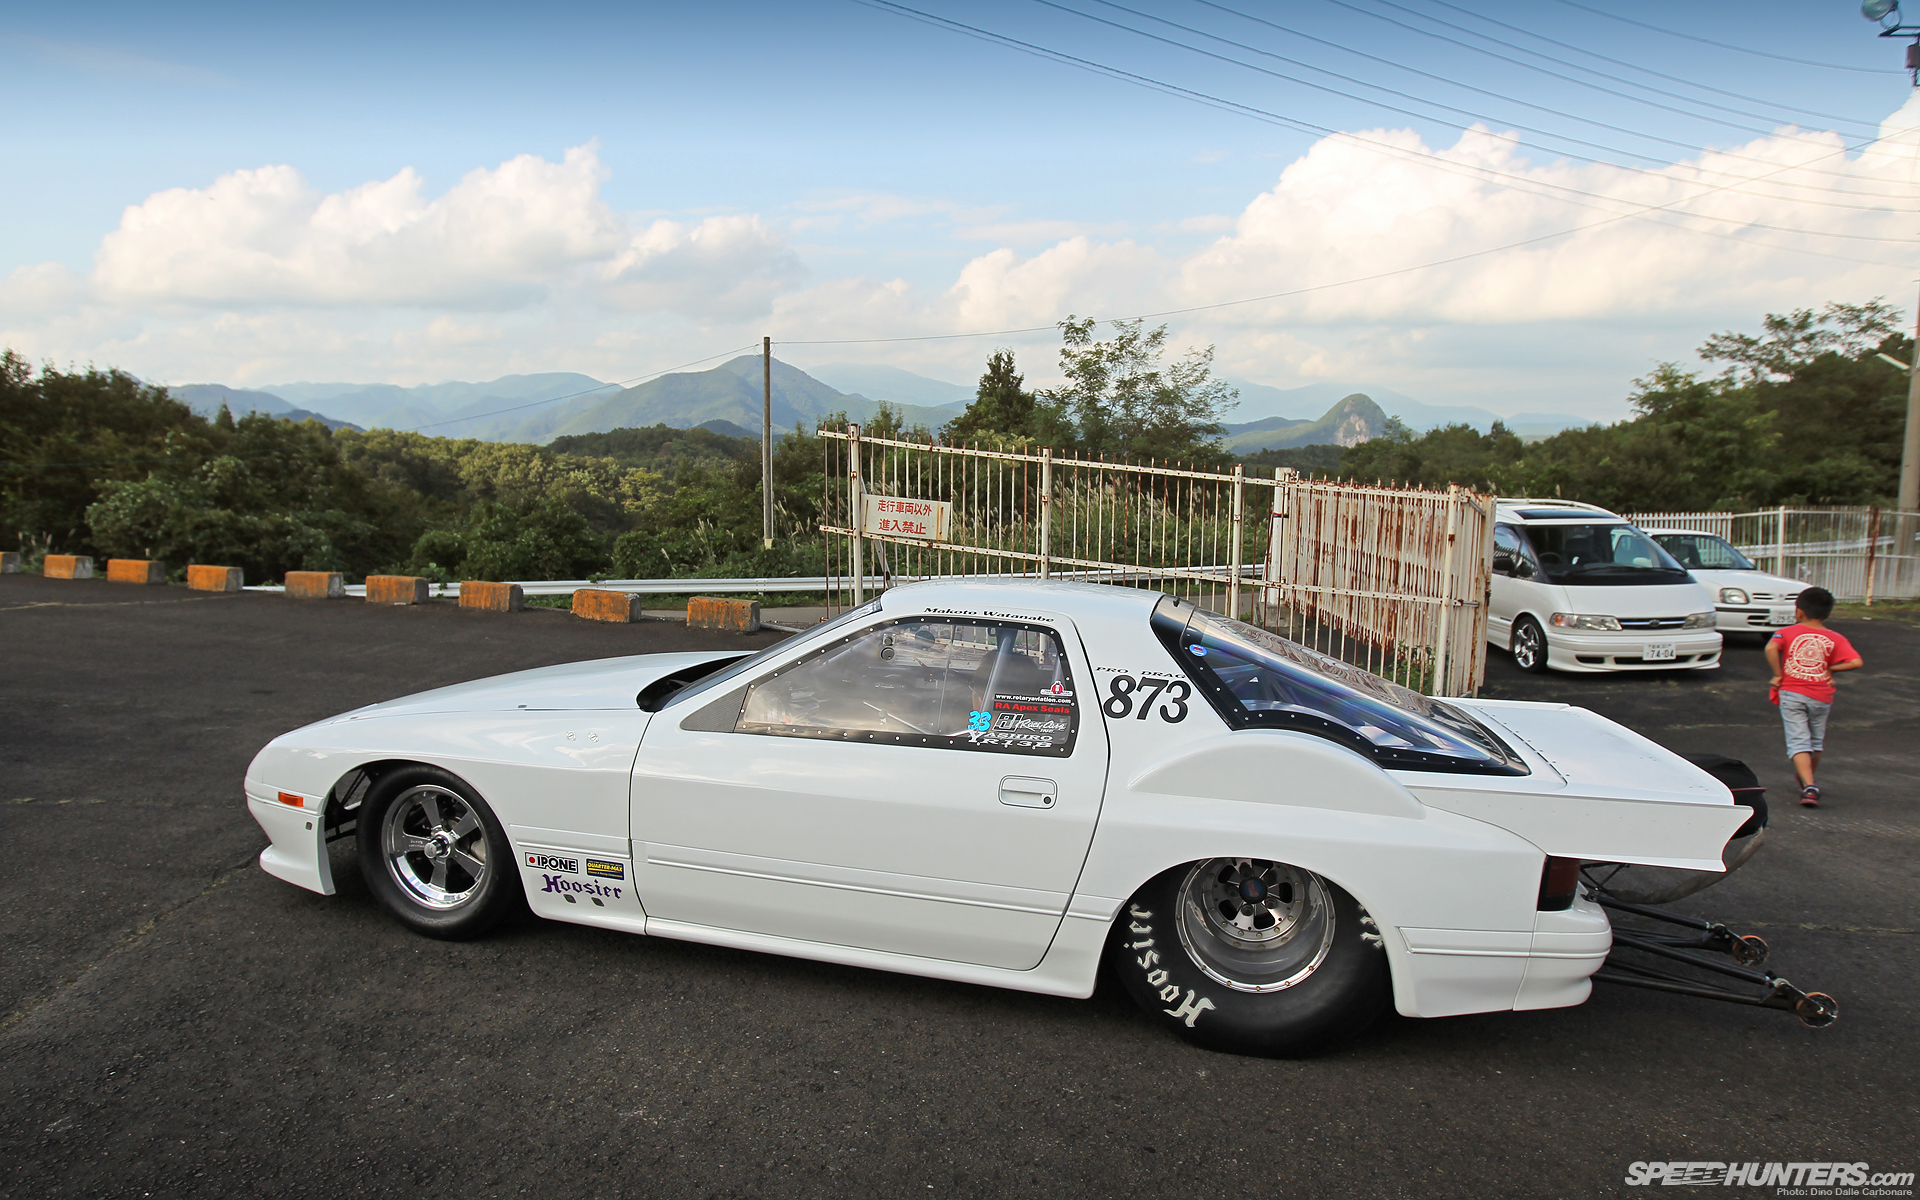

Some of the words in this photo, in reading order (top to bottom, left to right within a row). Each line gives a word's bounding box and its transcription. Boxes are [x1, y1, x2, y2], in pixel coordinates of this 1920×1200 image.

[877, 499, 932, 517] 走行車両以外
[878, 518, 927, 535] 進入禁止
[923, 607, 978, 616] Makoto
[982, 610, 1055, 623] Watanabe
[1095, 666, 1129, 674] PRO
[1140, 670, 1187, 679] DRAG
[995, 694, 1072, 704] www.rotaryaviation.com
[1103, 674, 1192, 724] 873
[994, 702, 1010, 710] RA
[1012, 703, 1038, 712] Apex
[1040, 705, 1070, 714] Seals
[967, 710, 992, 732] 33
[537, 855, 577, 871] IPONE
[587, 862, 623, 873] QUARTER-MAX
[541, 873, 622, 900] Hoosier
[1123, 902, 1217, 1028] Hoosier
